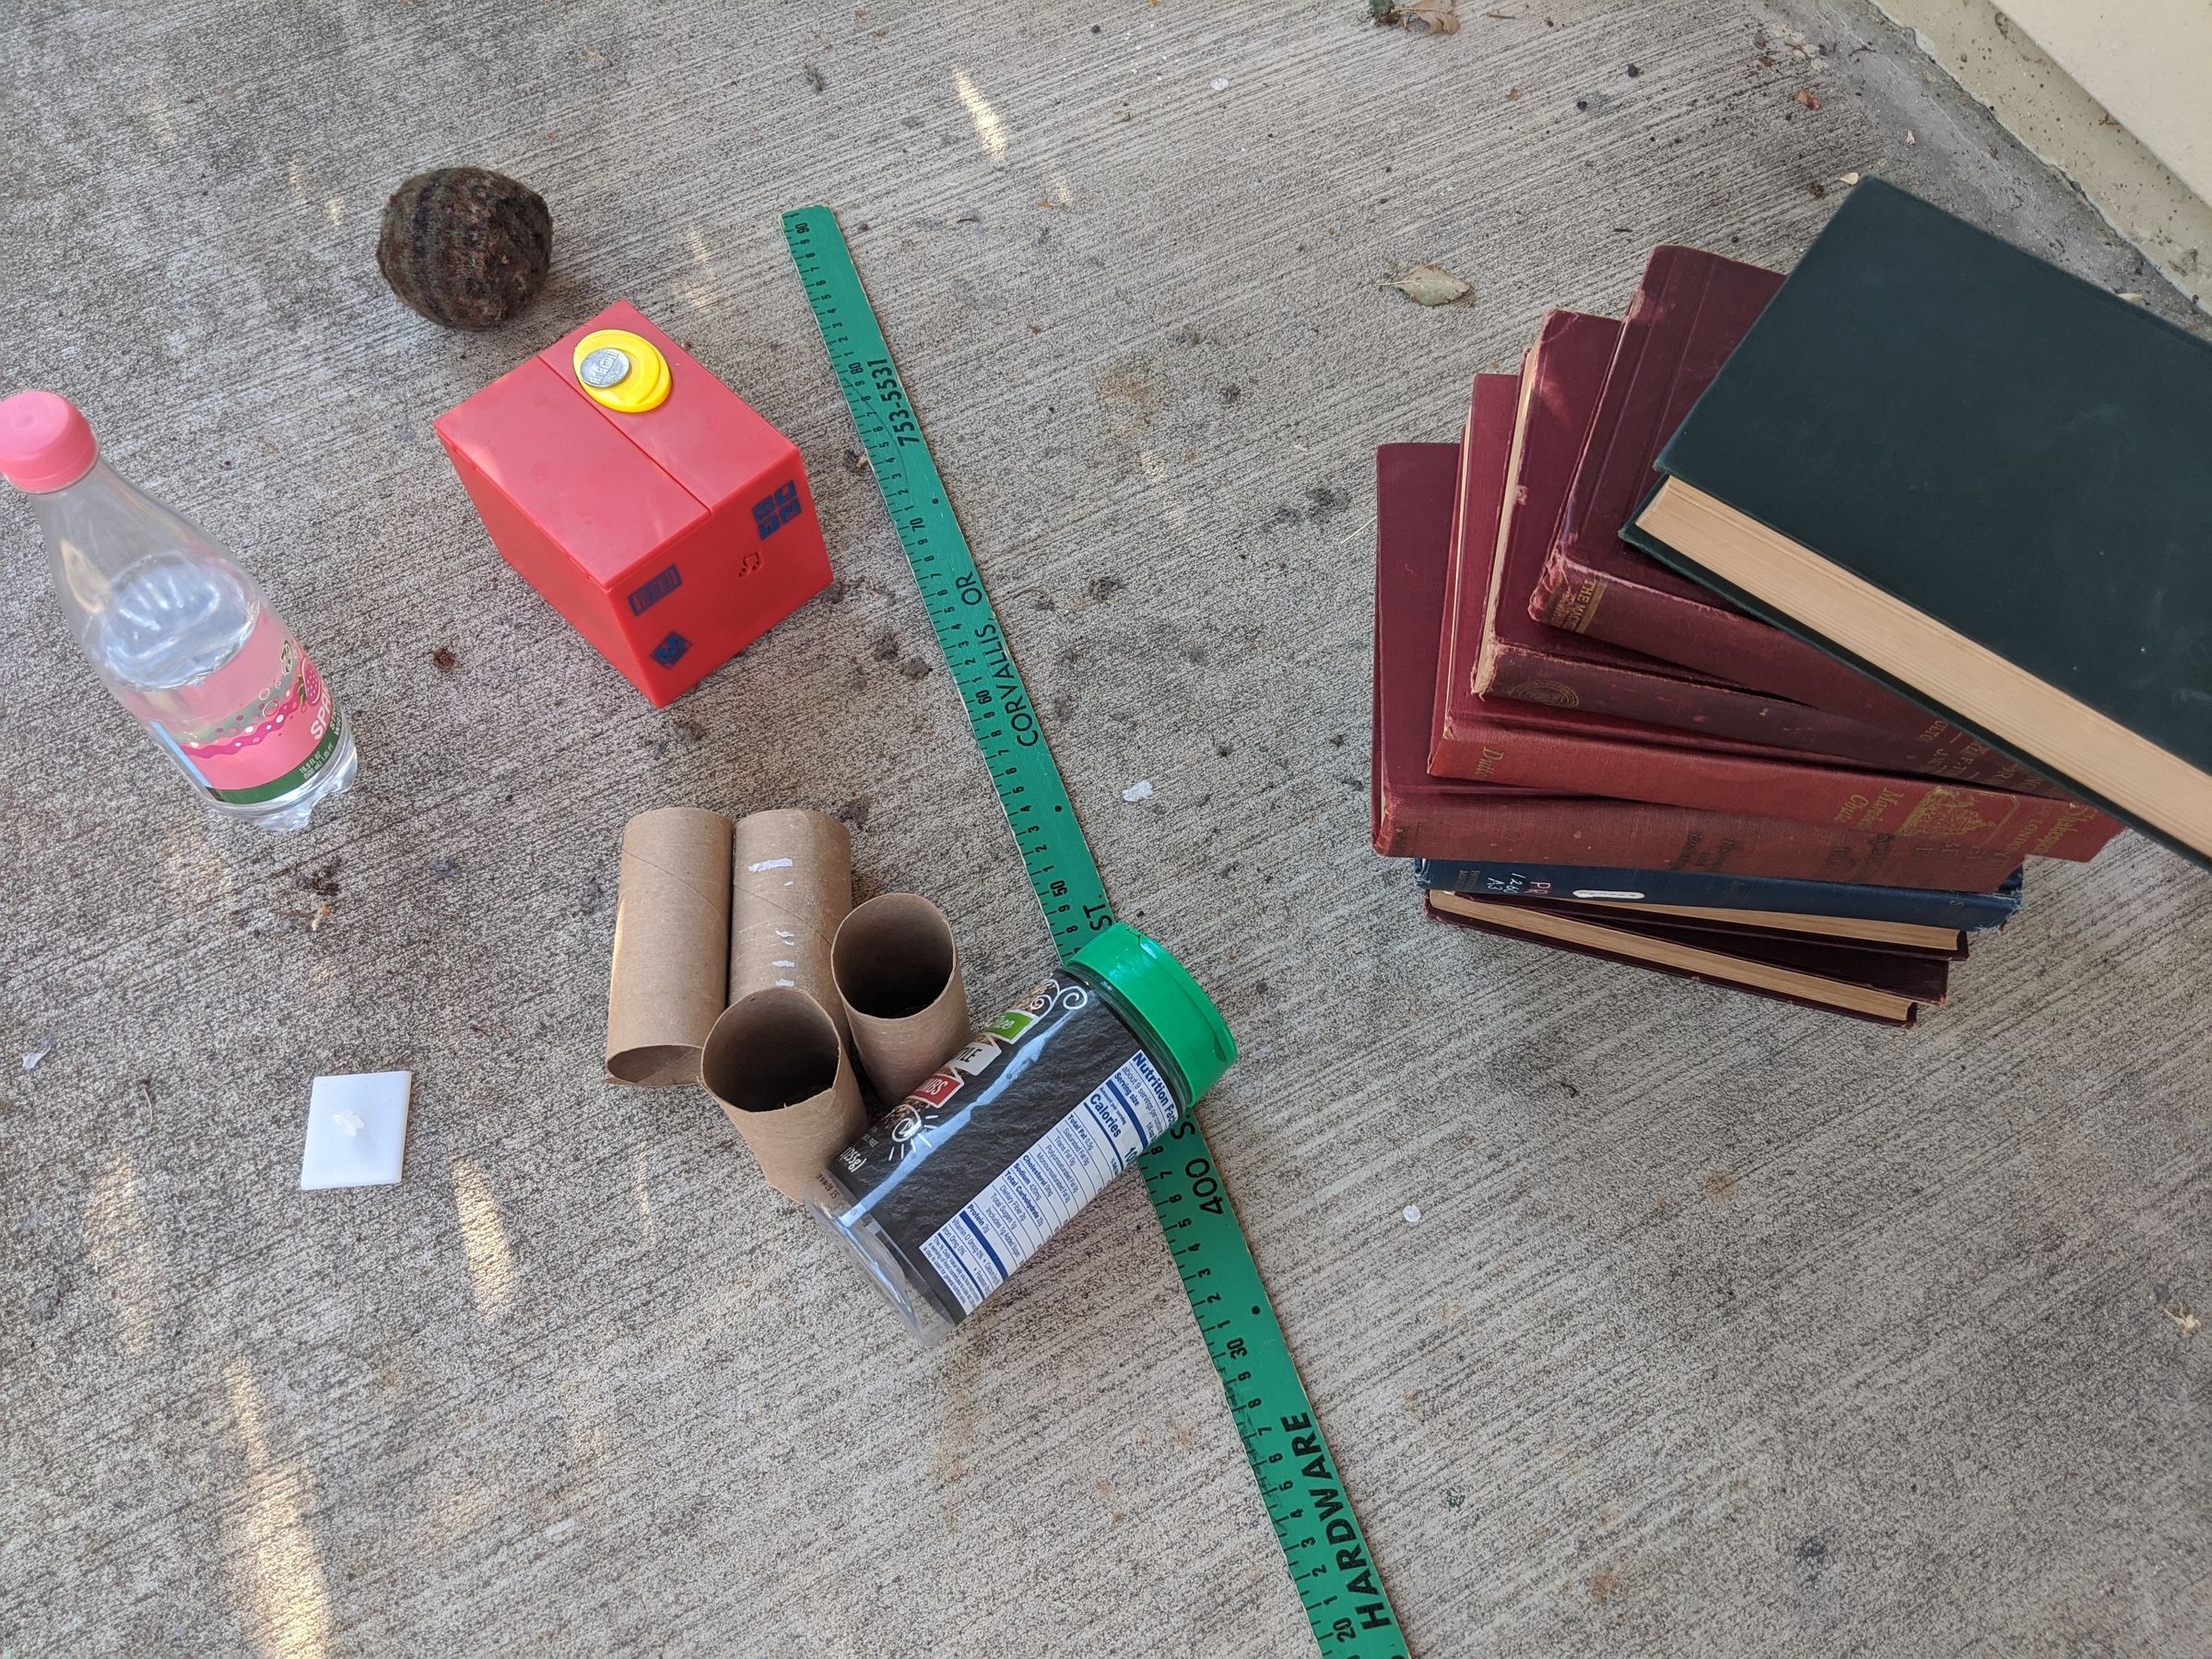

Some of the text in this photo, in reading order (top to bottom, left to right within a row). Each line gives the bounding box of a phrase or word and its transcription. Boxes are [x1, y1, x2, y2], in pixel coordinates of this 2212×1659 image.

[795, 222, 809, 234] 90
[848, 361, 863, 375] 80
[867, 359, 920, 447] 753-5531
[910, 517, 925, 532] 70
[1576, 579, 1597, 603] THE
[956, 571, 1039, 747] CORVALLIS, OR
[964, 657, 976, 665] 2
[975, 688, 993, 705] 60
[983, 711, 994, 719] 9
[990, 730, 1002, 738] 8
[1005, 767, 1018, 775] 6
[1028, 825, 1040, 833] 3
[1035, 844, 1048, 853] 2
[1041, 865, 1055, 873] 1
[1050, 879, 1068, 898] 50
[1058, 904, 1071, 912] 9
[1083, 894, 1113, 931] ST.
[1066, 924, 1078, 934] 8
[1133, 1052, 1169, 1107] Nutrition
[1114, 1072, 1140, 1107] Serving size
[1122, 1066, 1137, 1083] about
[1137, 1088, 1153, 1110] servings
[1149, 1107, 1158, 1117] per
[1100, 1087, 1126, 1125] Amount per serving
[1090, 1093, 1122, 1138] Calories
[1068, 1113, 1094, 1151] Total Fat 0.5g
[1054, 1135, 1077, 1167] Trans Fat 0g
[1063, 1127, 1089, 1167] Saturated Fat 0g
[1150, 1146, 1164, 1156] 8
[1045, 1144, 1073, 1182] Polyunsaturated
[1022, 1154, 1053, 1198] Cholesterol 0mg
[1035, 1152, 1064, 1192] Monounsaturated
[1159, 1171, 1173, 1180] 7
[1014, 1162, 1041, 1202] Sodium 420mg
[1185, 1159, 1224, 1215] 400
[999, 1184, 1027, 1222] Dietary Fiber 2g
[1005, 1171, 1018, 1187] Total
[1016, 1185, 1040, 1219] Carbohydrate
[1168, 1194, 1182, 1205] 6
[967, 1204, 990, 1234] Protein 2g
[990, 1192, 1018, 1230] Total Sugars 1g
[985, 1206, 1002, 1230] Includes
[999, 1226, 1006, 1236] 1g
[1003, 1231, 1015, 1247] Added
[1178, 1218, 1192, 1229] 5
[942, 1225, 952, 1238] Iron
[949, 1235, 959, 1250] 0mg
[951, 1217, 968, 1237] Vitamin
[967, 1238, 979, 1254] 0mcg
[1187, 1242, 1201, 1253] 4
[1197, 1267, 1211, 1279] 3
[1207, 1292, 1221, 1304] 2
[1217, 1319, 1231, 1329] 1
[1226, 1337, 1248, 1360] 30
[1238, 1371, 1252, 1382] 9
[1248, 1397, 1263, 1409] 8
[1257, 1426, 1272, 1437] 7
[1268, 1453, 1283, 1464] 6
[1278, 1480, 1294, 1492] 5
[1280, 1412, 1392, 1630] HARDWARE
[1289, 1508, 1304, 1519] 4
[1300, 1536, 1316, 1548] 3
[1312, 1564, 1327, 1578] 2
[1323, 1594, 1338, 1606] 1
[1333, 1617, 1357, 1642] 20
